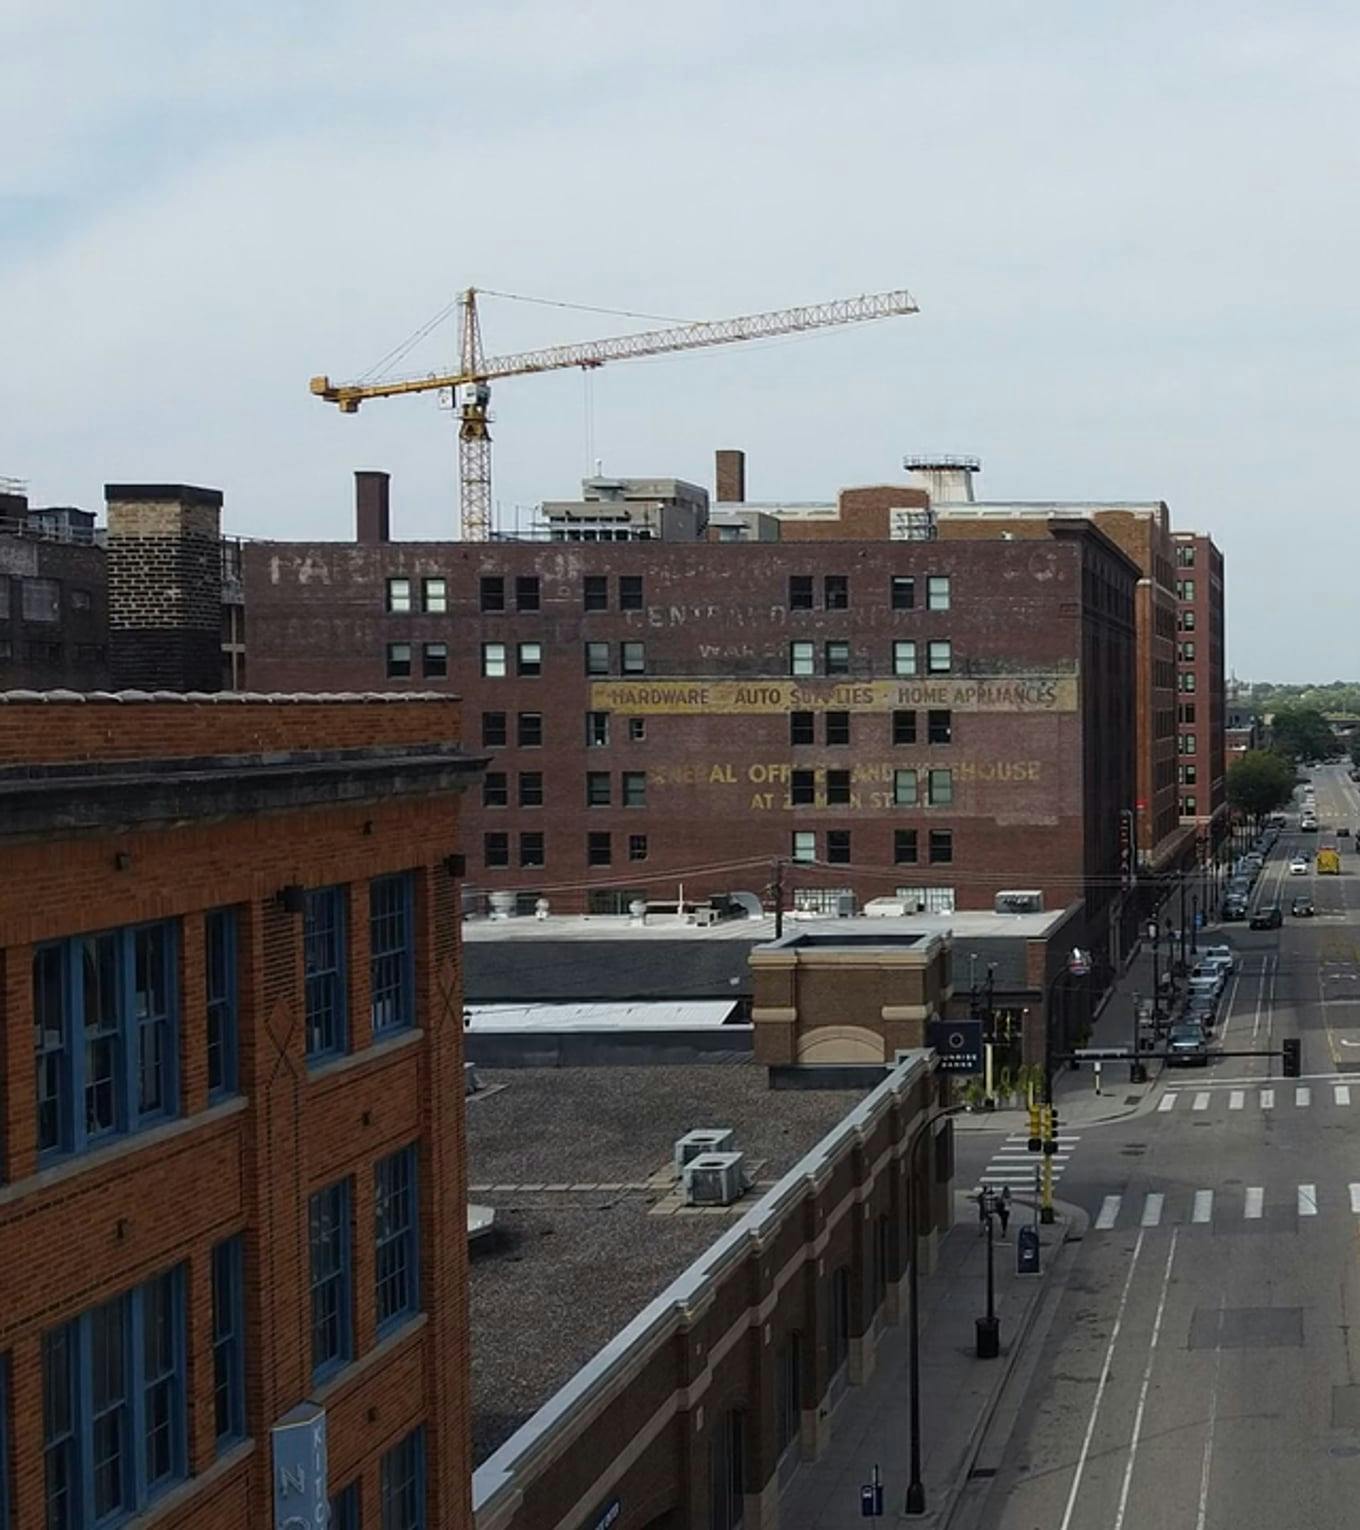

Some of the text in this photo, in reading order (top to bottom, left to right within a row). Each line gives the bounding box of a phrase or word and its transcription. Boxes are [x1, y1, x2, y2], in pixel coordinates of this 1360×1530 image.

[610, 686, 1056, 705] HARDWARE AUTO SULIES HOME APPLIANCES
[749, 763, 848, 784] OFFE
[751, 794, 774, 811] AT
[937, 1053, 977, 1061] UNRISE
